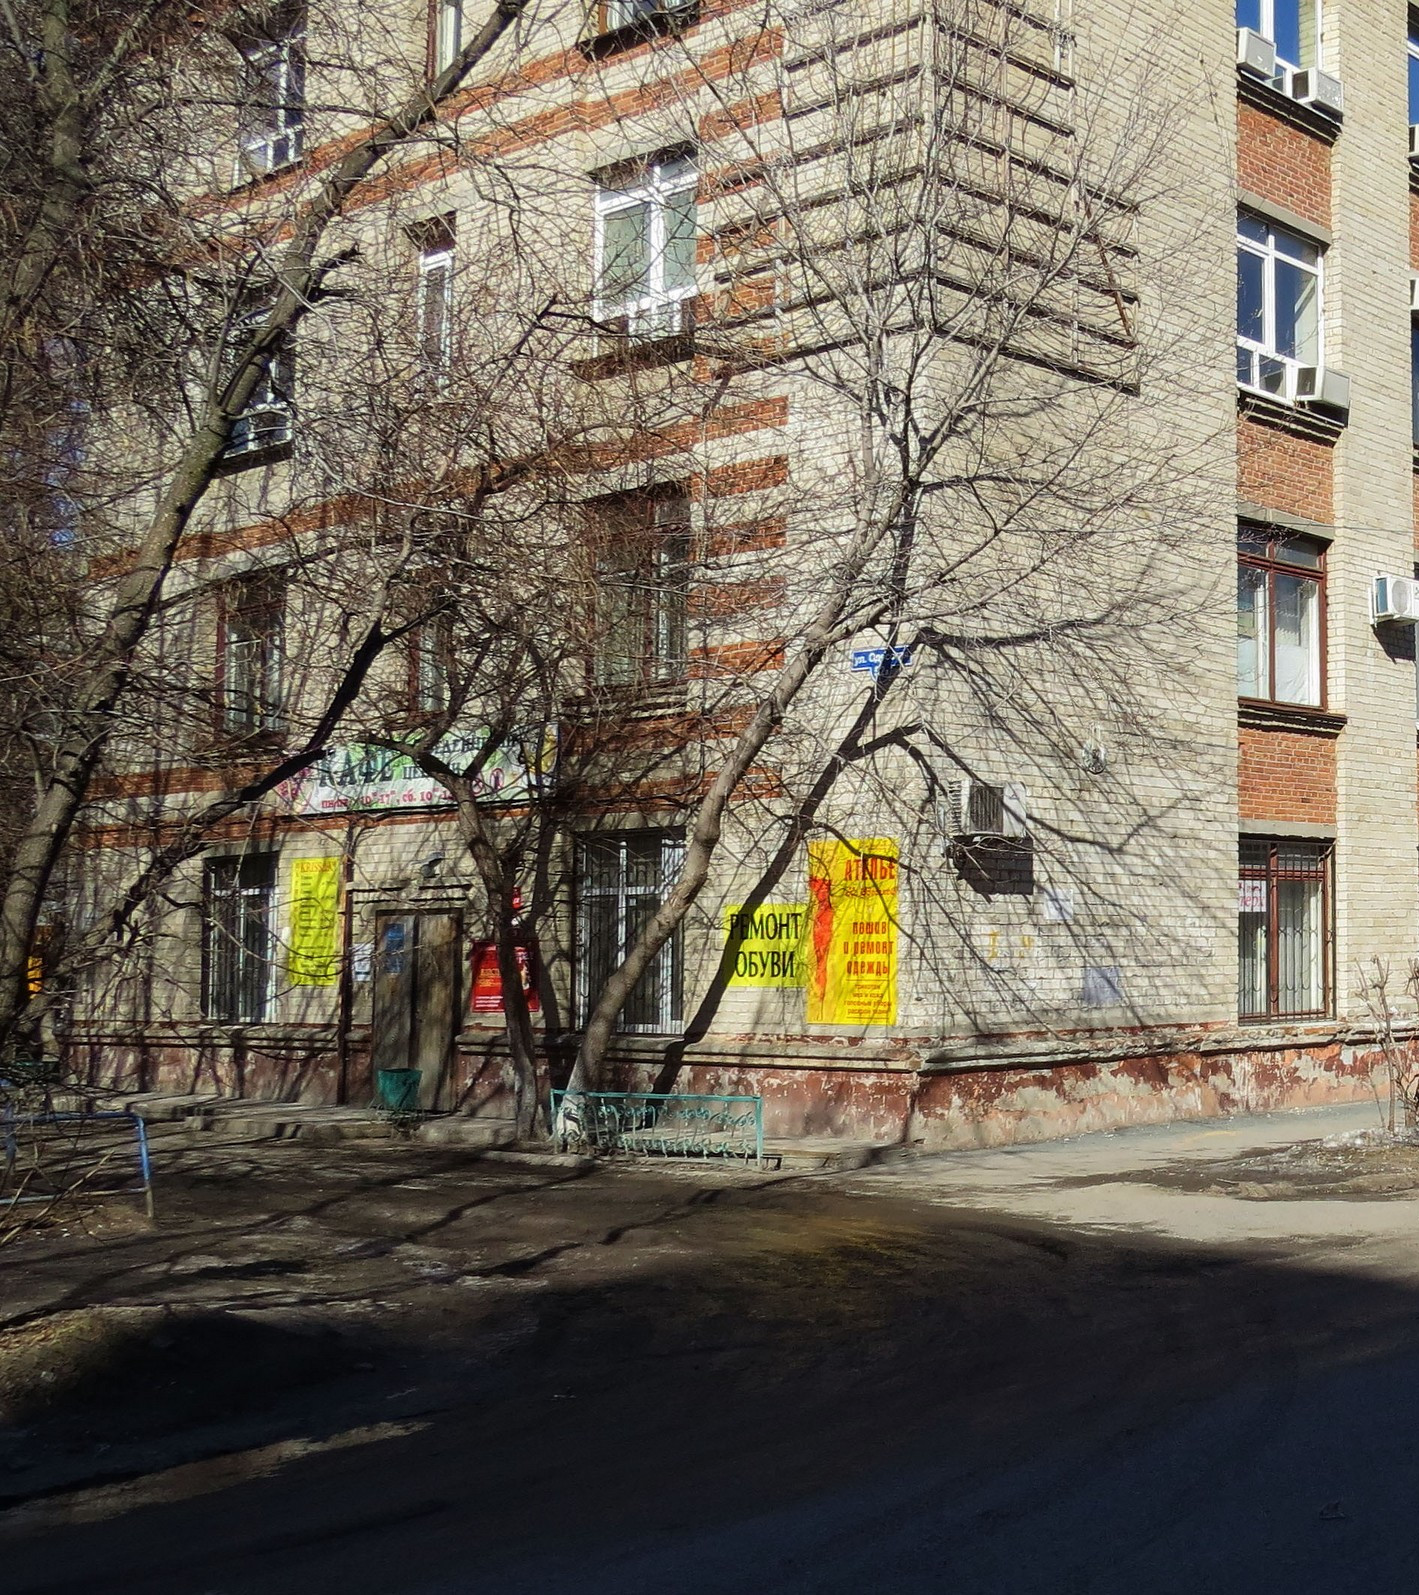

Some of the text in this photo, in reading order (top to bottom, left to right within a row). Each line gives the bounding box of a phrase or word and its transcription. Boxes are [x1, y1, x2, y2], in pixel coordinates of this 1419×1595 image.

[854, 655, 867, 666] ул.
[845, 857, 895, 881] АТЕЛЬЕ
[730, 912, 802, 940] РЕМОНТ
[852, 921, 887, 935] пошив
[853, 941, 894, 957] ремонт
[735, 951, 795, 978] ОБУВИ
[846, 960, 889, 976] одежды
